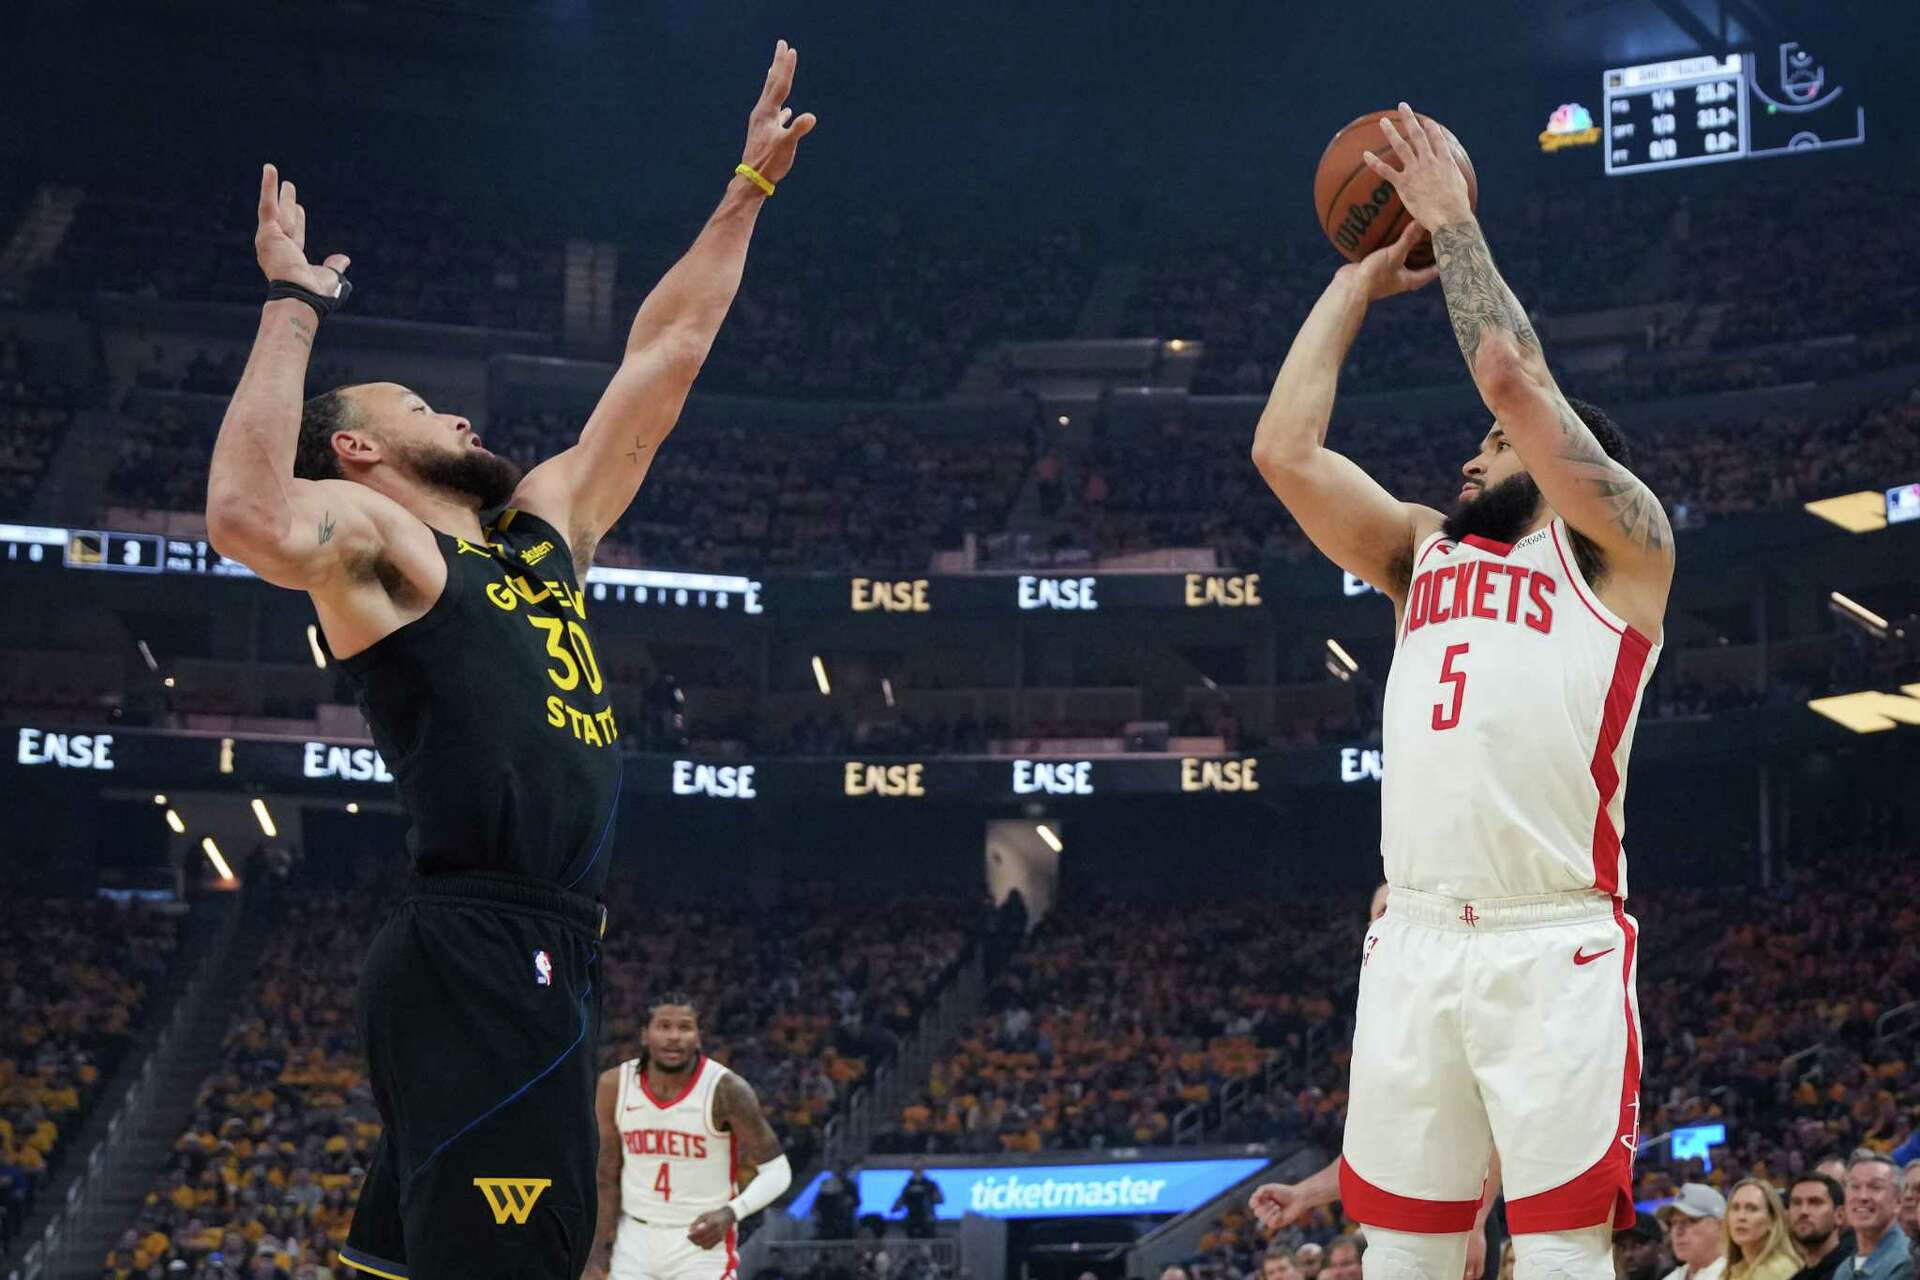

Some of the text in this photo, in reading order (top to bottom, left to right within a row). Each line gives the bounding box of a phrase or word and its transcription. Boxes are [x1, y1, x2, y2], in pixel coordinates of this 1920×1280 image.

[1335, 181, 1394, 251] Wilso
[852, 579, 929, 611] ENSE
[1018, 576, 1098, 609] ENSE
[1186, 574, 1260, 606] ENSE
[1403, 560, 1556, 635] OCKETS
[527, 614, 602, 695] 30
[1431, 643, 1469, 731] 5
[18, 728, 114, 769] ENSE
[673, 760, 757, 798] ENSE
[845, 762, 925, 795] ENSE
[1013, 760, 1093, 794] ENSE
[1181, 758, 1259, 791] ENSE
[623, 1129, 707, 1159] ROCKETS
[654, 1163, 671, 1202] 4
[970, 1176, 1165, 1210] ticketmaster
